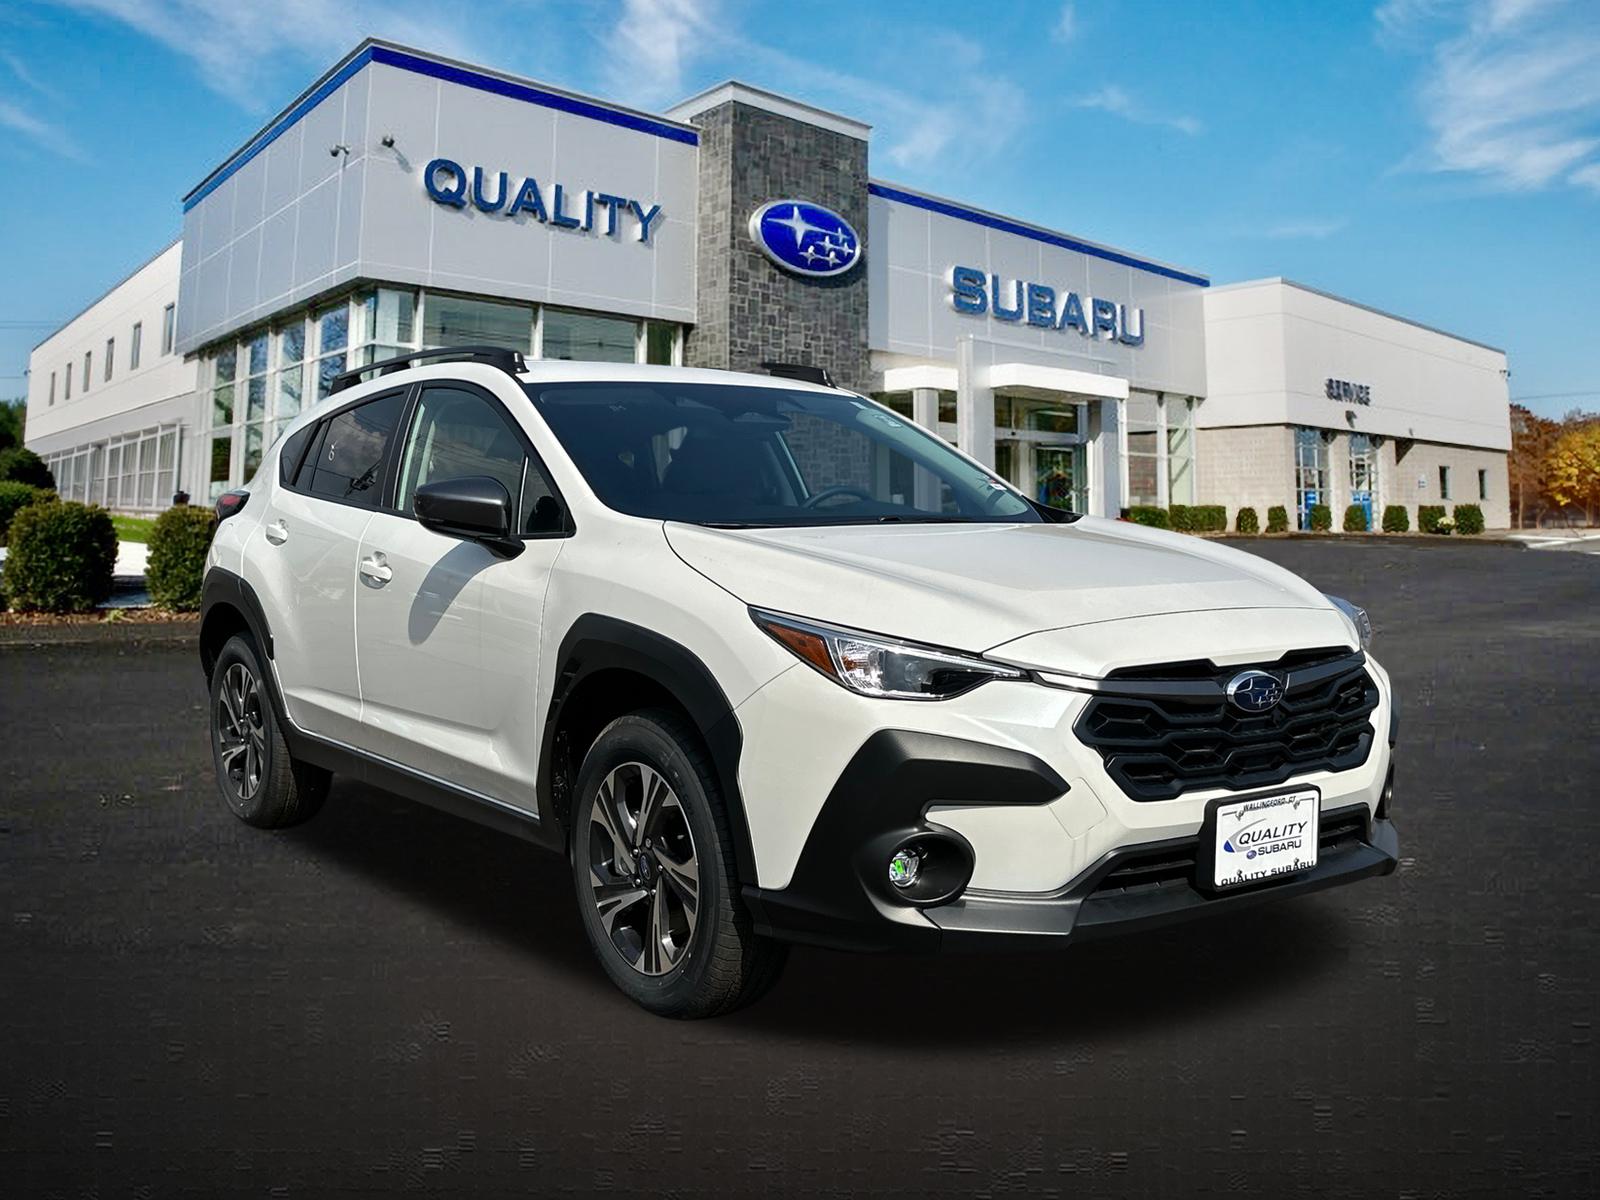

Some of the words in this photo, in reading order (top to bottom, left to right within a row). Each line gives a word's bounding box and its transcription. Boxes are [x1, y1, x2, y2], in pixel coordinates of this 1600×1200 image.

[422, 157, 662, 243] QUALITY
[950, 265, 1145, 347] SUBARU
[1239, 821, 1307, 845] QUALITY
[1257, 839, 1301, 856] SUBARU
[1220, 869, 1267, 886] QUALITY
[1270, 860, 1315, 876] SUBARU
